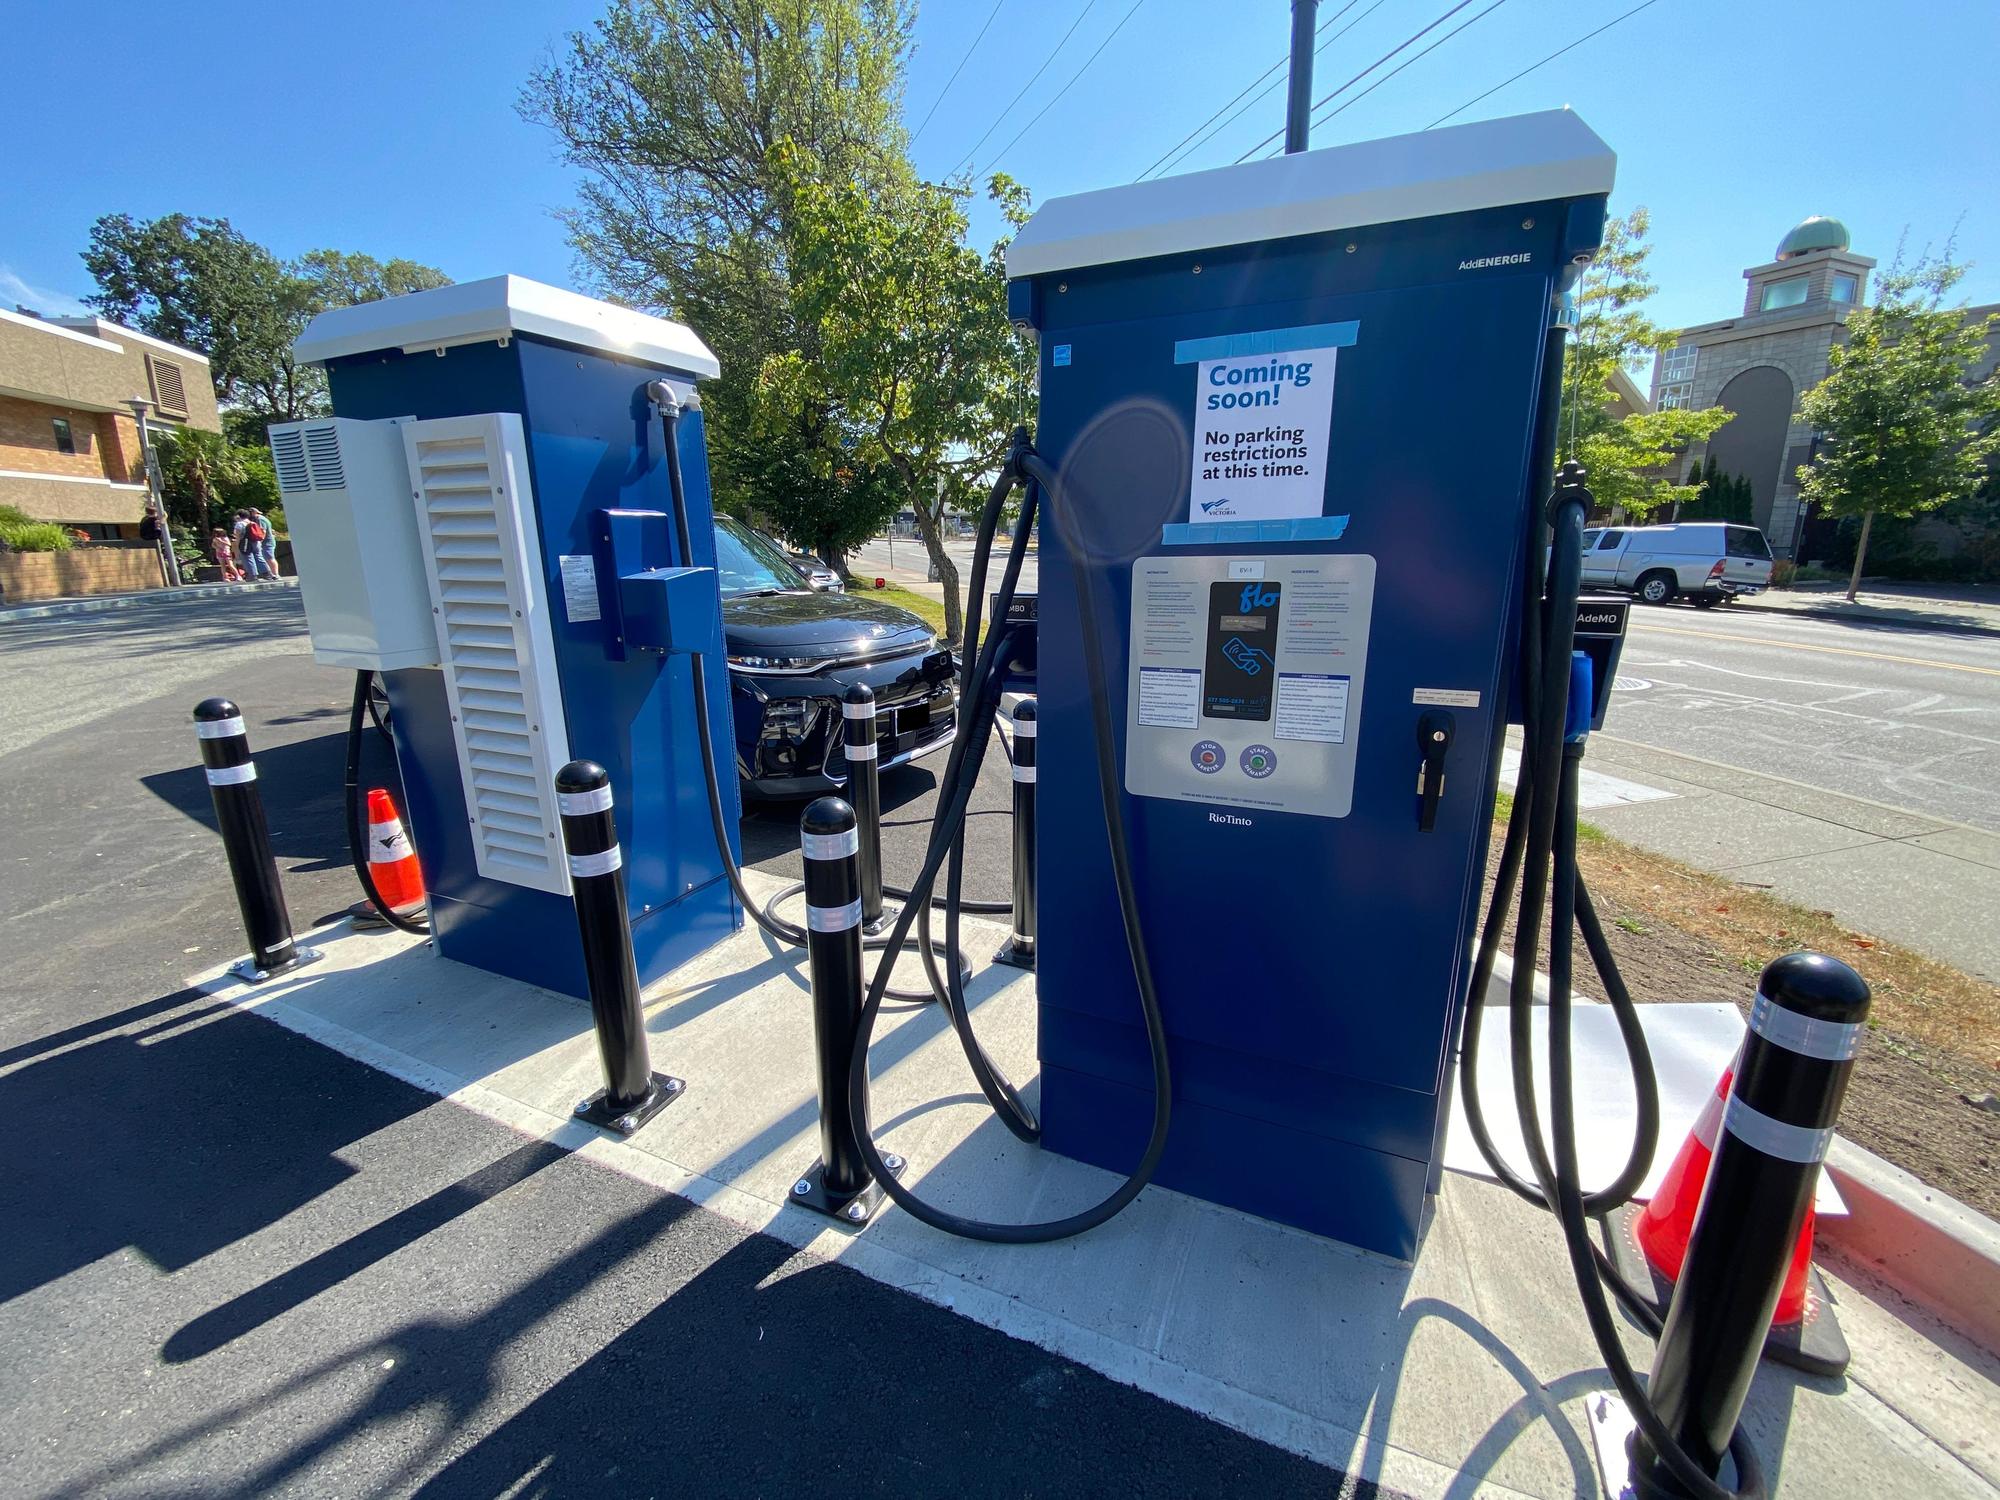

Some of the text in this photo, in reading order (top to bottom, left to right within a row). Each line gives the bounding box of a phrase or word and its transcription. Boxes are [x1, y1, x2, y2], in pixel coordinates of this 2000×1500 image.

[1458, 252, 1532, 270] AddENERGIE
[1209, 359, 1313, 387] Coming
[1207, 384, 1281, 410] soon!
[1205, 426, 1305, 447] No parking
[1204, 444, 1308, 463] restrictions
[1202, 461, 1309, 480] at this time.
[1240, 582, 1281, 614] flo
[1576, 613, 1617, 623] AdeMO
